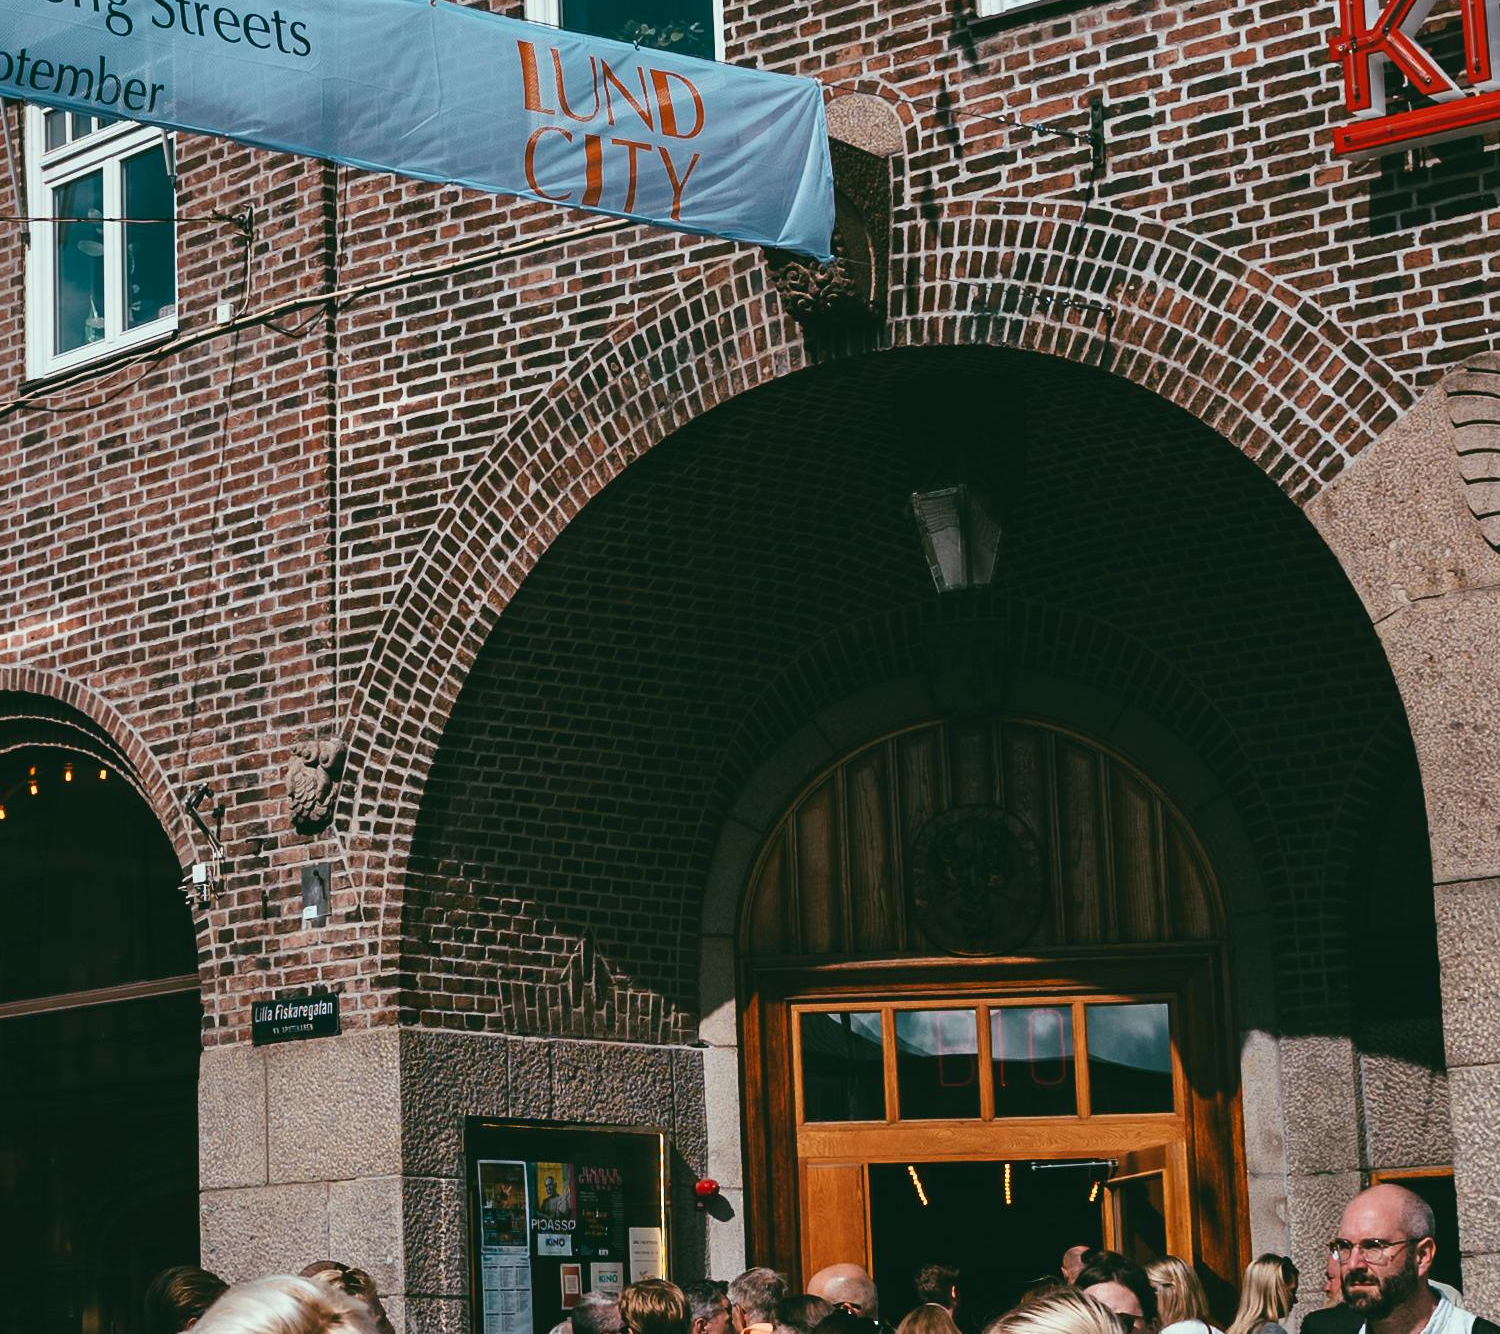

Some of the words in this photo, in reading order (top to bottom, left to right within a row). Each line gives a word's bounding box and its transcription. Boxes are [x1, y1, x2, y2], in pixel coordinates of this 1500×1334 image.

[516, 39, 706, 140] LUND
[523, 125, 701, 222] CITY
[254, 1006, 273, 1024] Lilla
[275, 999, 333, 1021] Fiskaregatan
